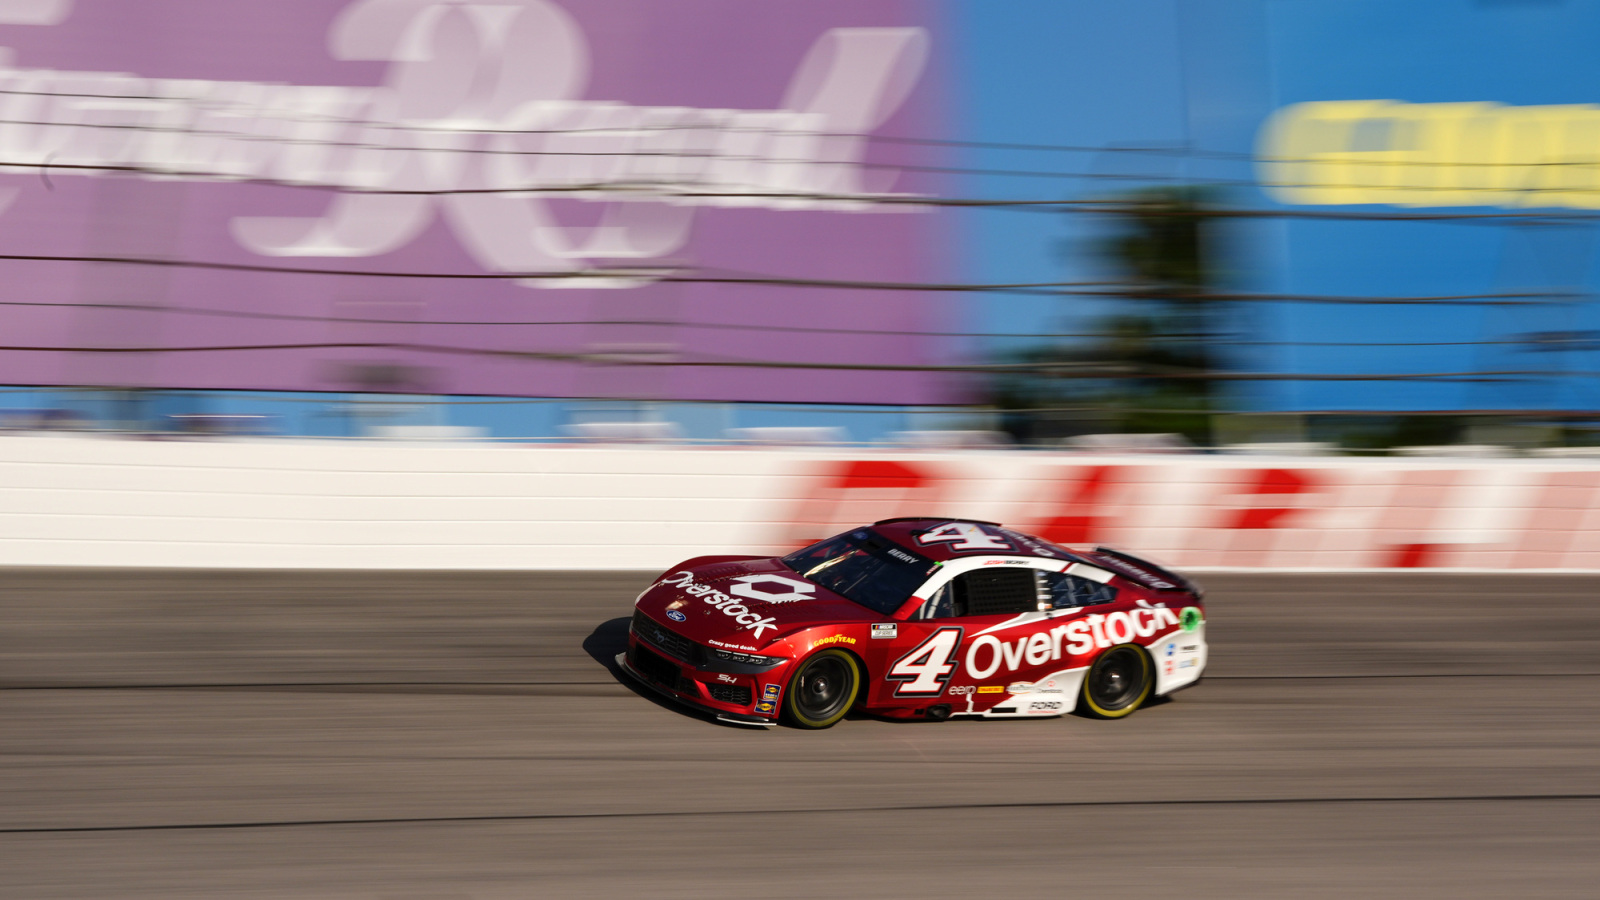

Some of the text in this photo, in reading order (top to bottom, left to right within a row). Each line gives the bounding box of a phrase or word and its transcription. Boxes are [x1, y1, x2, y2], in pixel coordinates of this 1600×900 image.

[915, 522, 1014, 551] 4
[887, 548, 919, 564] BERRY
[661, 571, 778, 640] Overstock
[708, 639, 724, 647] Crazy
[813, 634, 856, 647] GOODYEAR
[965, 599, 1178, 679] Overstock
[886, 627, 962, 697] 4
[1030, 702, 1063, 710] FORD
